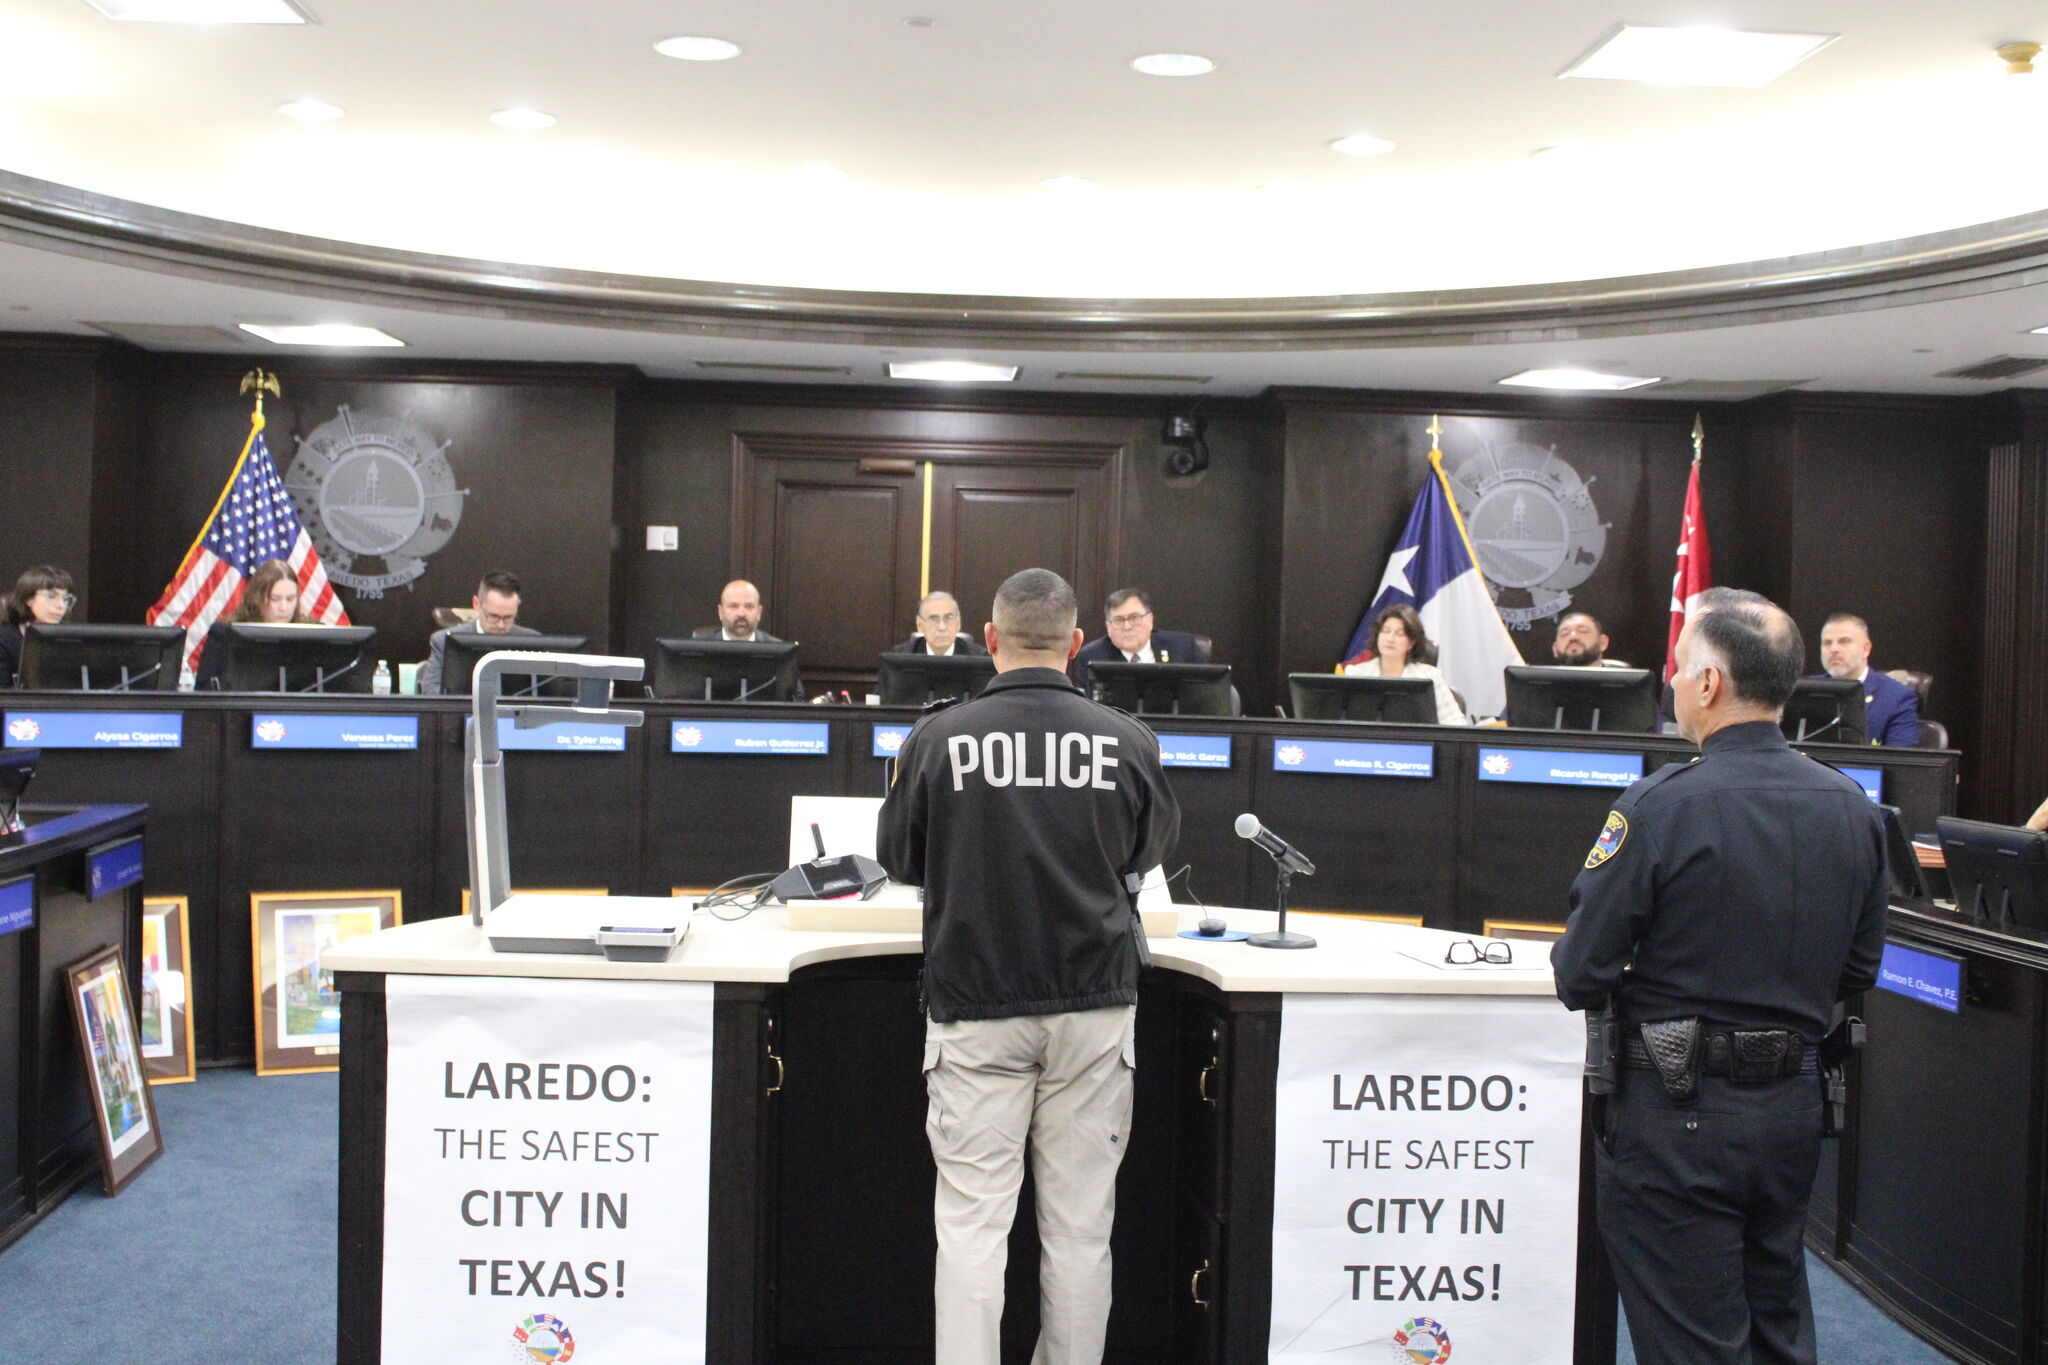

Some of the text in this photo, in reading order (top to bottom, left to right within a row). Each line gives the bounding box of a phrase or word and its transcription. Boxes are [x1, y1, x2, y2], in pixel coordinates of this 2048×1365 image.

[376, 571, 414, 587] TEXAS
[356, 588, 384, 600] 1755
[1524, 601, 1561, 619] TEXAS
[94, 732, 179, 742] Alyssa Cigarroa
[341, 733, 414, 742] Vanessa Perez
[573, 736, 597, 745] Tyler
[600, 737, 622, 746] King
[734, 739, 767, 747] Ruben
[948, 732, 1119, 792] POLICE
[1175, 752, 1196, 761] Rick
[1198, 753, 1228, 762] Garza
[1386, 761, 1430, 771] Cigarroa
[1550, 769, 1590, 779] Ricardo
[1591, 772, 1628, 782] Rangel
[1882, 969, 1907, 985] Ramon
[1915, 980, 1943, 998] Chavez,
[1944, 988, 1958, 1001] P.E.
[444, 1061, 651, 1102] LAREDO:
[1333, 1074, 1527, 1111] LAREDO:
[434, 1128, 659, 1162] THE SAFEST
[1322, 1139, 1534, 1170] THE SAFEST
[461, 1189, 628, 1229] CITY IN
[1347, 1198, 1504, 1235] CITY IN
[459, 1259, 625, 1299] TEXAS!
[1344, 1264, 1501, 1301] TEXAS!
